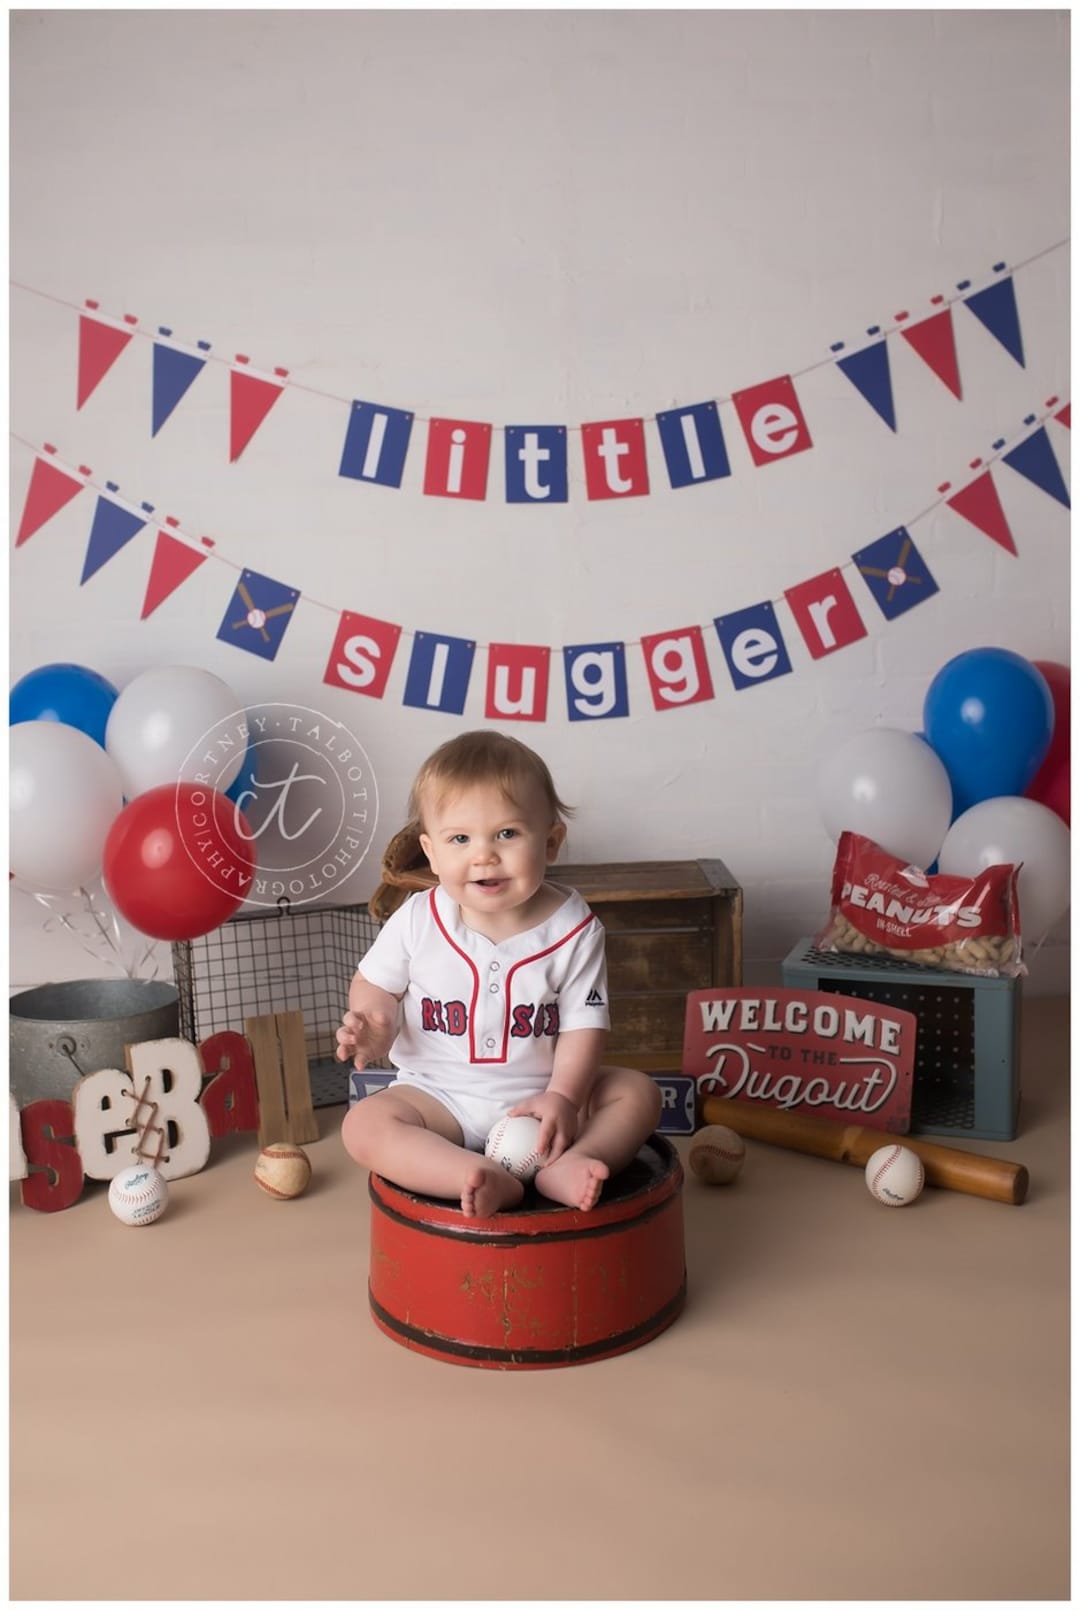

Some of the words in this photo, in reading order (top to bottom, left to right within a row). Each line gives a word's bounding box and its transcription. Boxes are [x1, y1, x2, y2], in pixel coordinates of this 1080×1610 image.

[362, 402, 799, 499] little
[336, 594, 838, 716] slugger
[841, 881, 982, 928] PEANUTS
[699, 999, 902, 1055] WELCOME
[768, 1045, 792, 1060] TO
[802, 1049, 838, 1066] THE
[696, 1043, 897, 1113] Dugout
